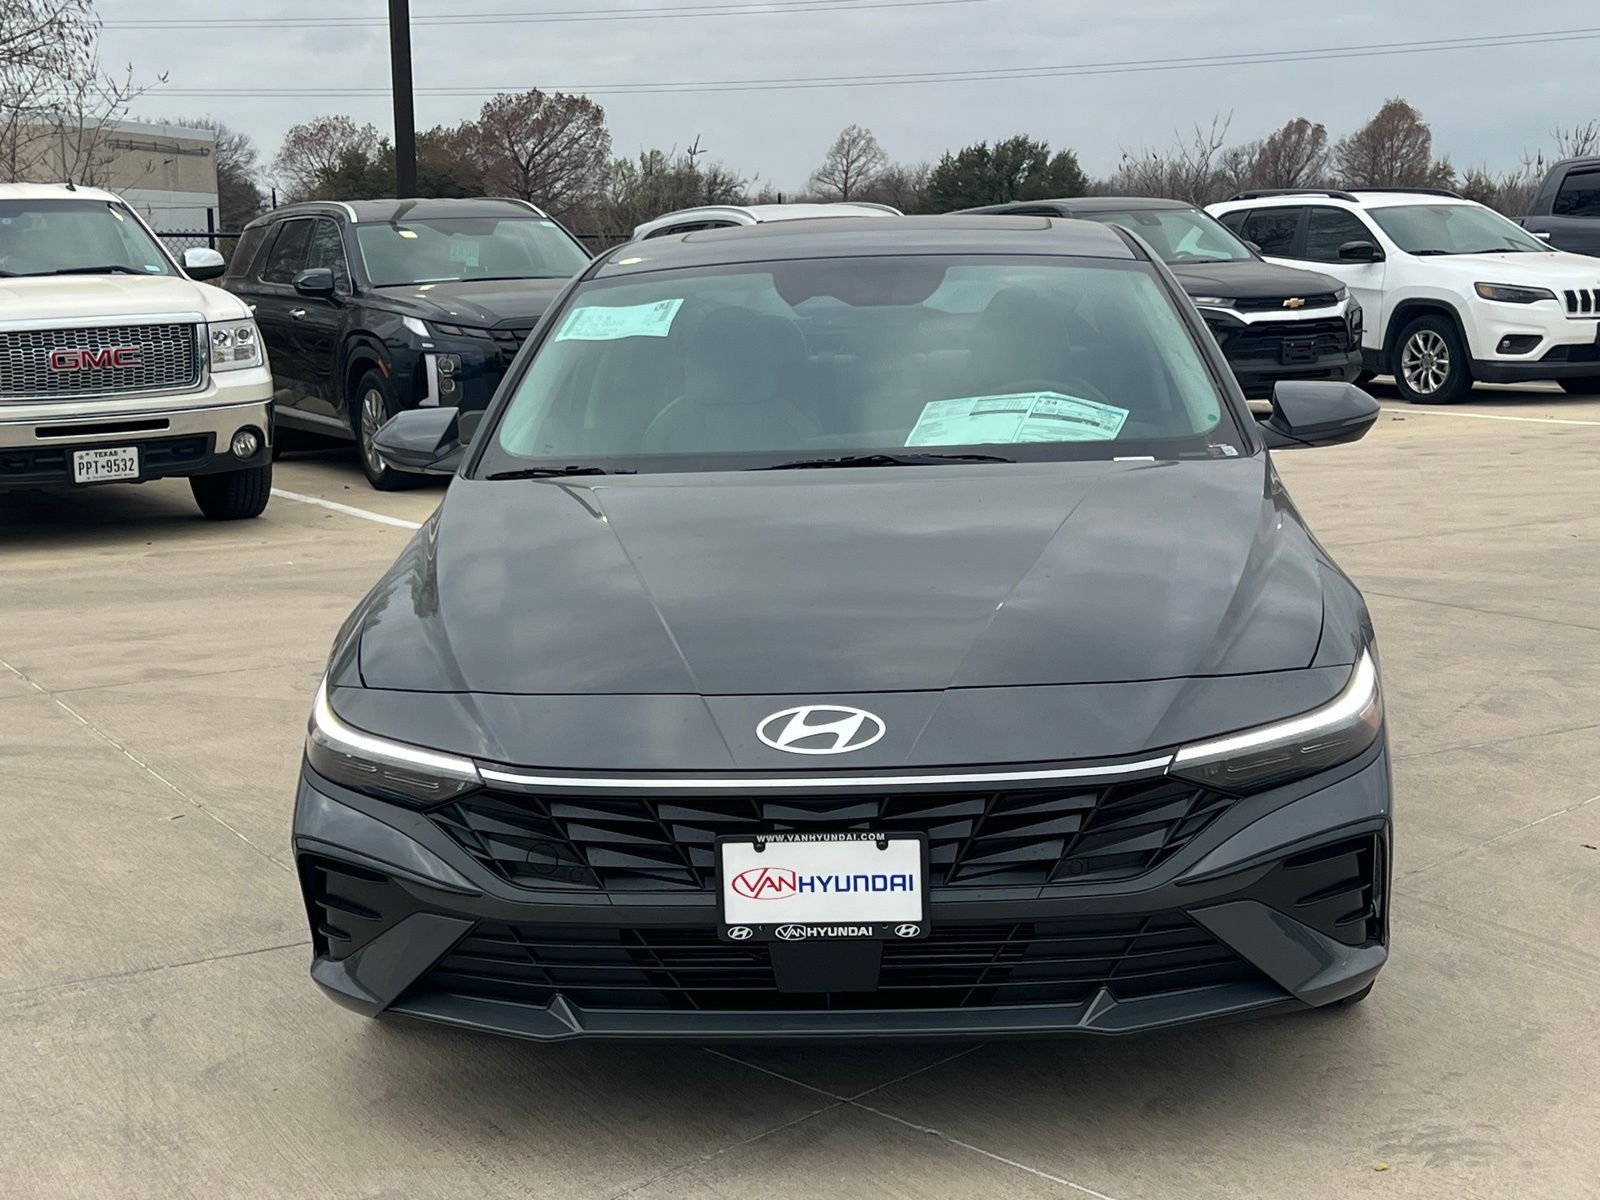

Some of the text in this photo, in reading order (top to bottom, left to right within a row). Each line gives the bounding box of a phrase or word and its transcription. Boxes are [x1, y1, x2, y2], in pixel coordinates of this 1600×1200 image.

[49, 345, 142, 372] GMC
[94, 450, 118, 458] TEXAS
[756, 833, 885, 843] WWW.VANHYUNDAI.COM
